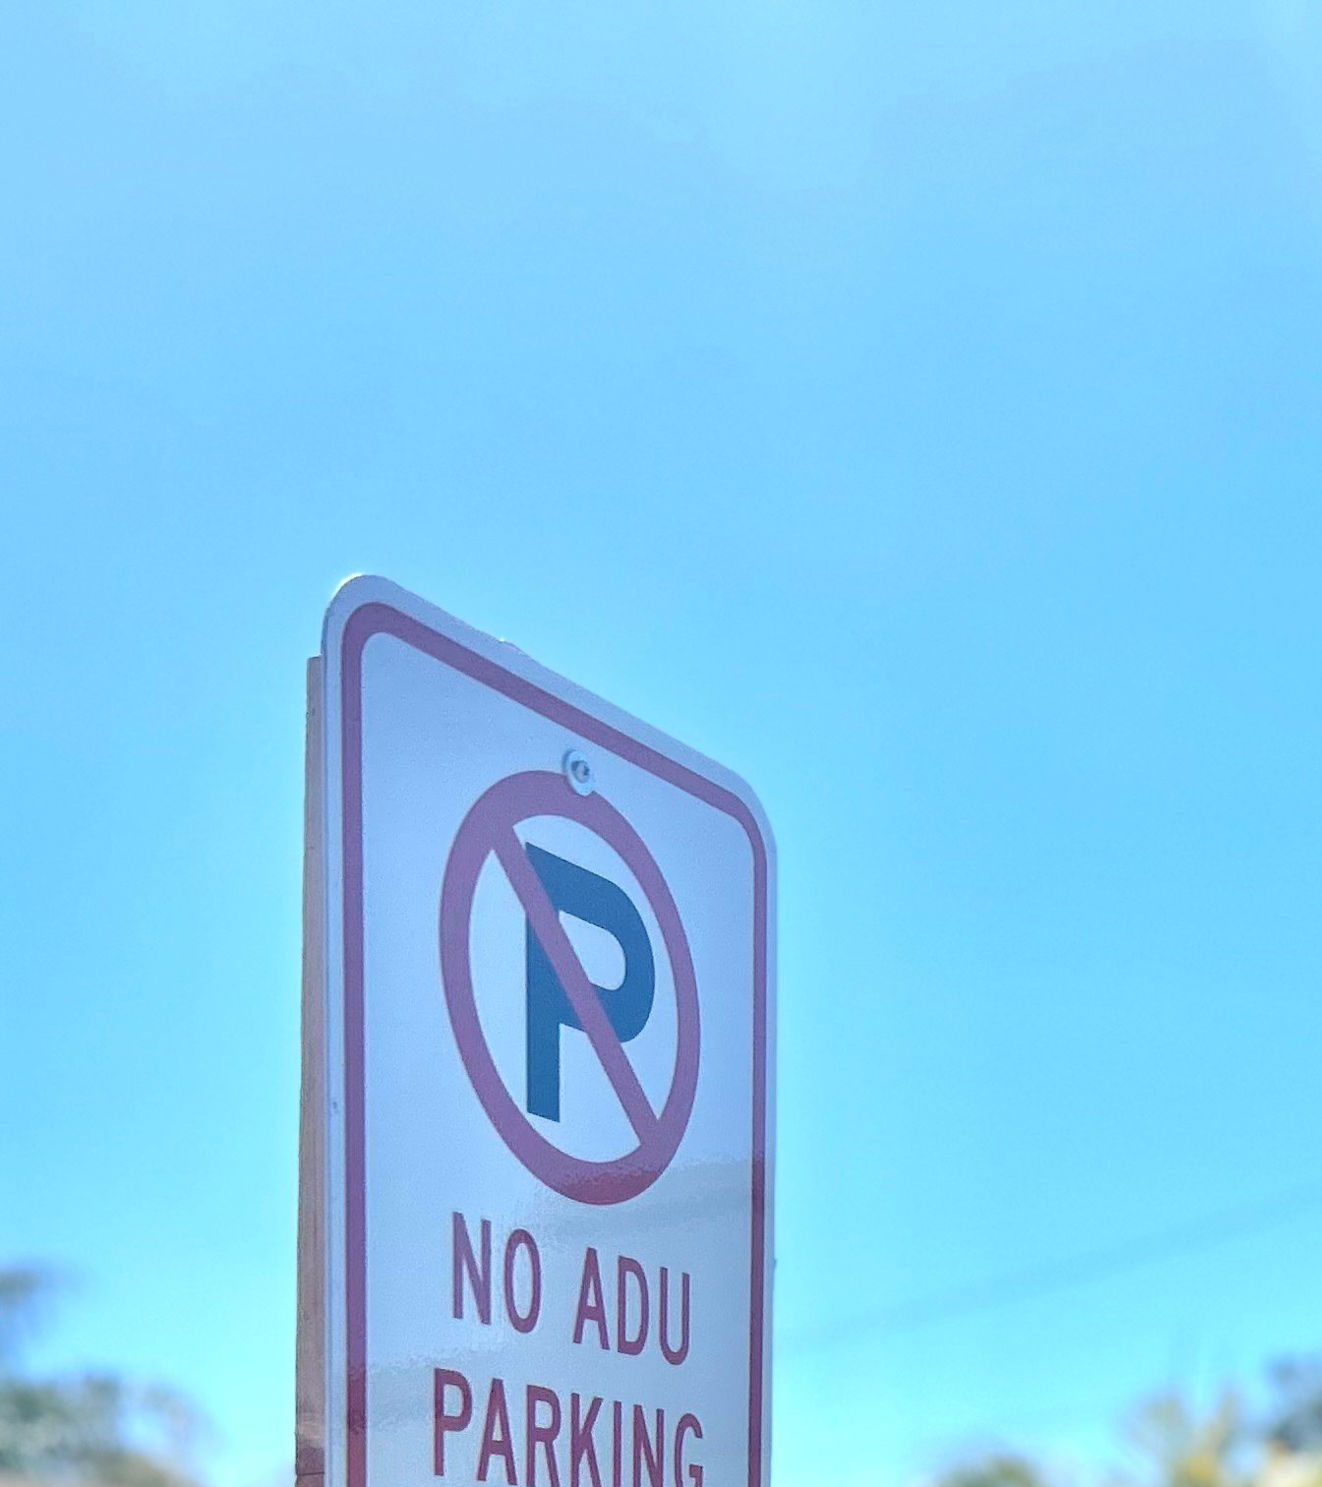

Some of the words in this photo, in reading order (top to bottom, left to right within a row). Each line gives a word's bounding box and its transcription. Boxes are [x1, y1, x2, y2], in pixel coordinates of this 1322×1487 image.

[525, 842, 655, 1122] P
[452, 1212, 541, 1334] NO
[573, 1247, 690, 1365] ADU
